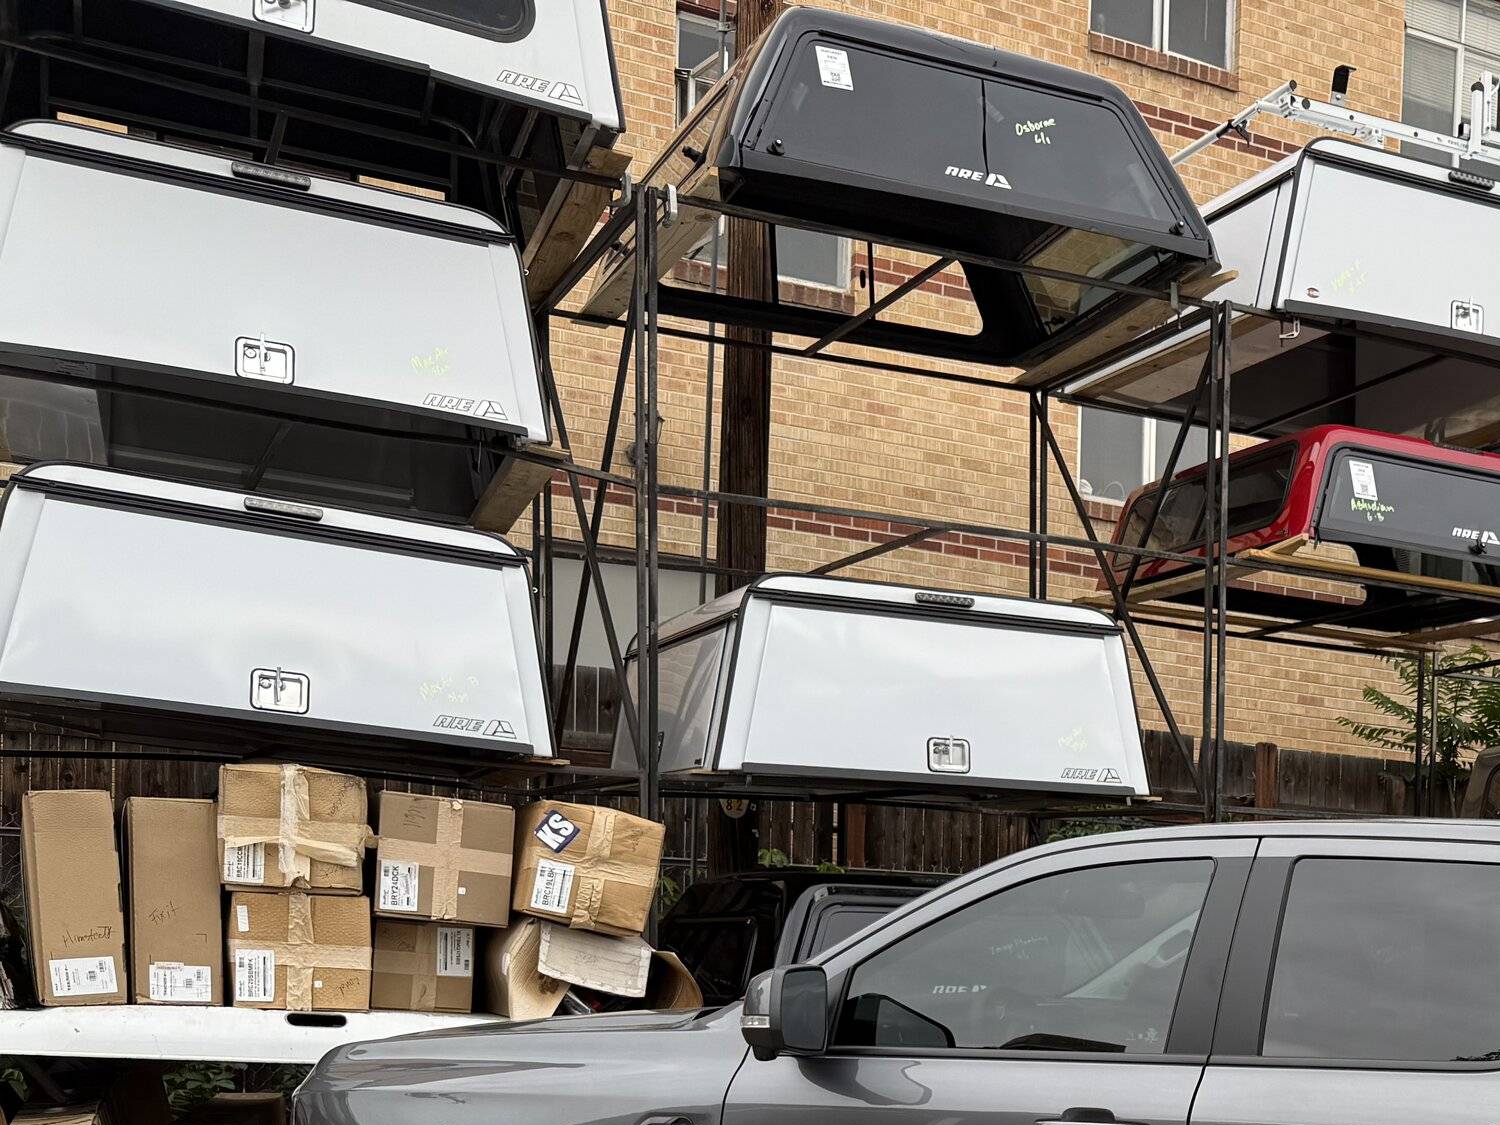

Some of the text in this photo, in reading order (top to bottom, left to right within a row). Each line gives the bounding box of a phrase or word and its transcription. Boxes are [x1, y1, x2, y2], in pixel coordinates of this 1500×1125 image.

[496, 69, 550, 93] ARE
[945, 165, 984, 181] ARE
[423, 393, 474, 411] ARE
[1452, 527, 1480, 540] ARE
[433, 715, 484, 731] ARE
[1061, 768, 1098, 780] ARE
[536, 813, 575, 850] KS
